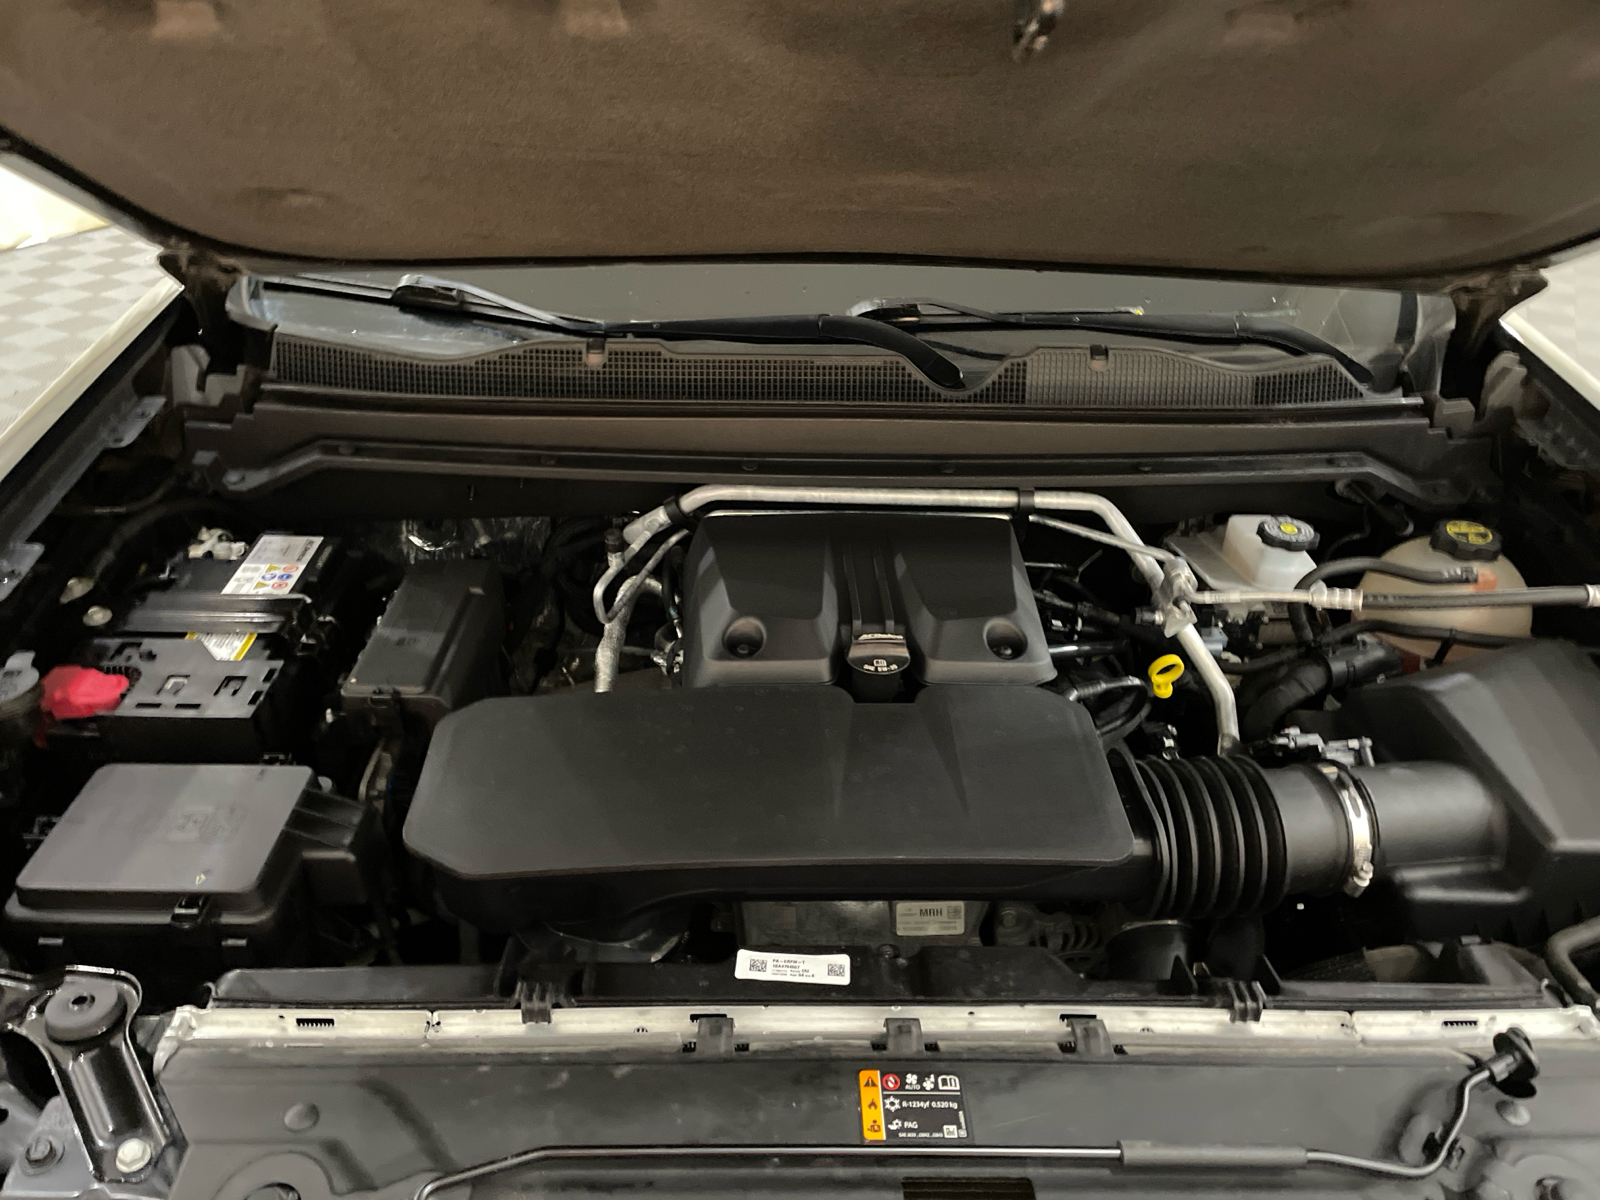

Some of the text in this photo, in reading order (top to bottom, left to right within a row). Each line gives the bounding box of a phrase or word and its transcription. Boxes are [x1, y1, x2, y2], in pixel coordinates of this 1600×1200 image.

[919, 908, 943, 917] MRH
[902, 1100, 958, 1110] R-1234yf 0.520 kg
[903, 1121, 918, 1129] PAG
